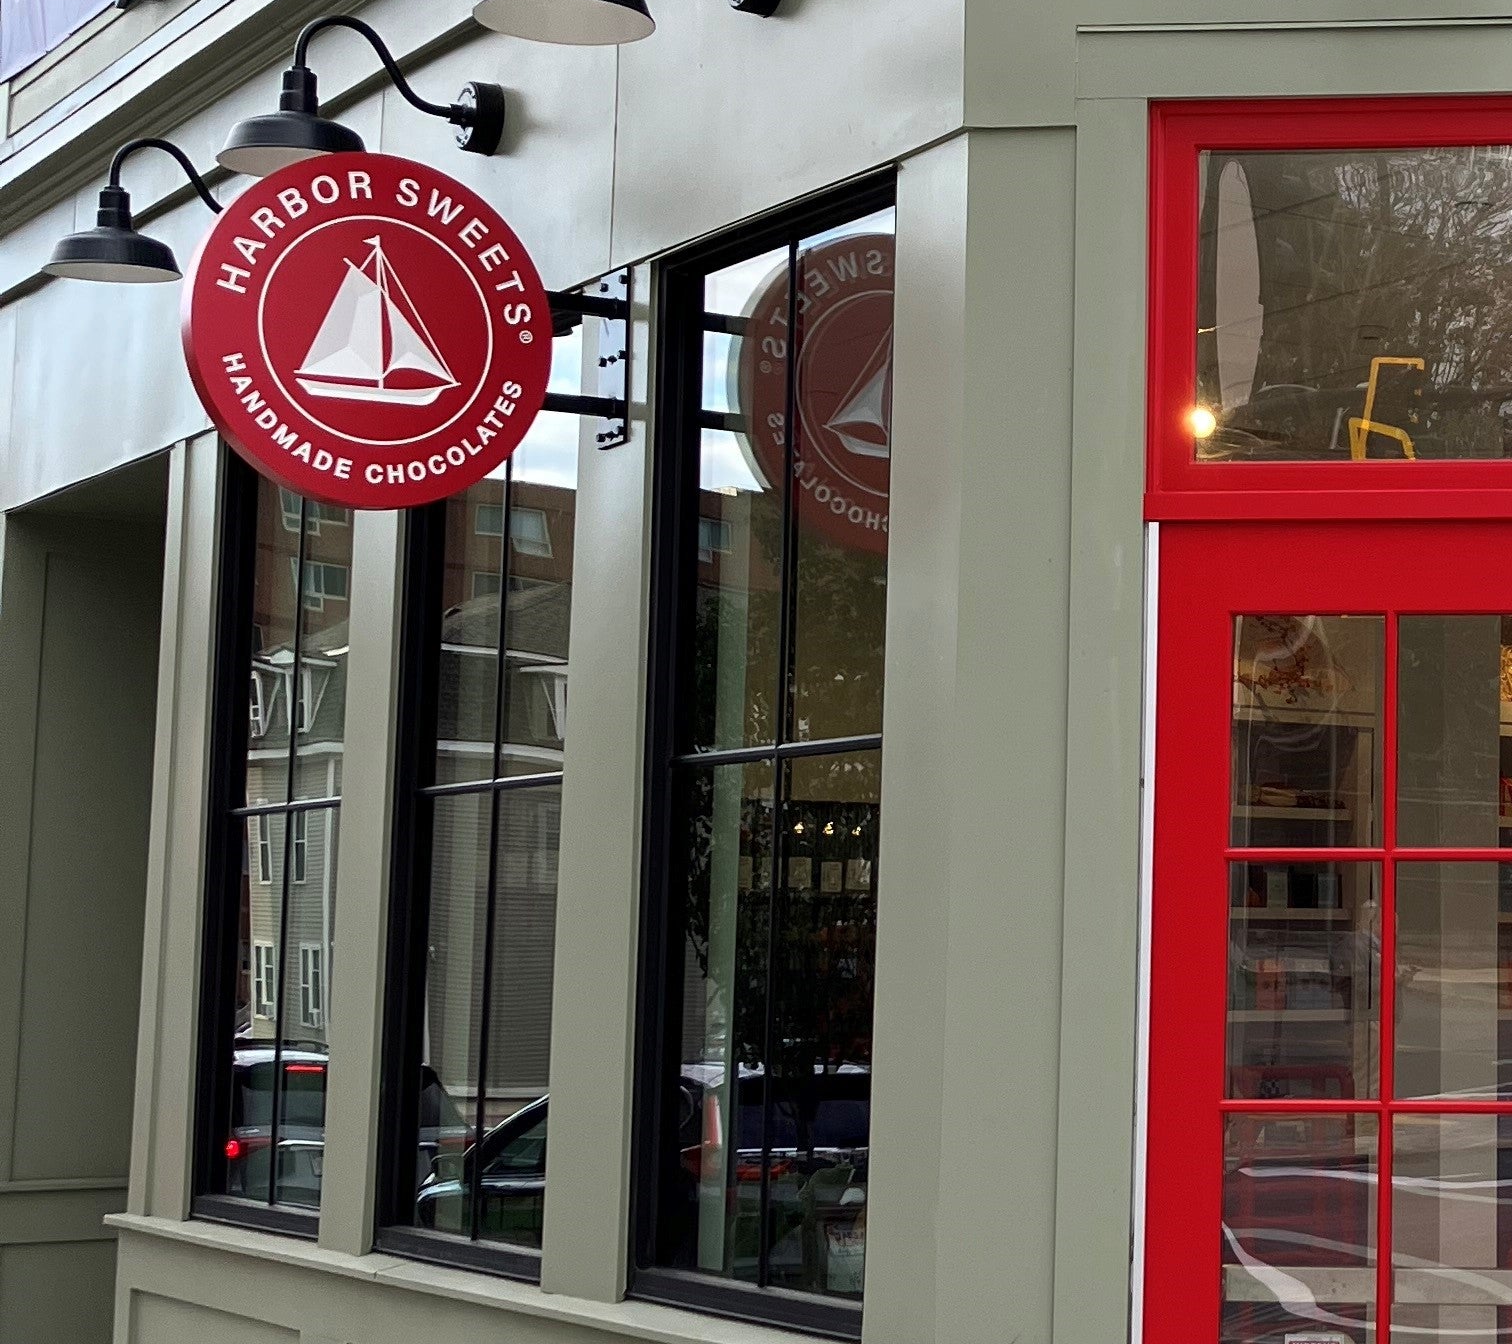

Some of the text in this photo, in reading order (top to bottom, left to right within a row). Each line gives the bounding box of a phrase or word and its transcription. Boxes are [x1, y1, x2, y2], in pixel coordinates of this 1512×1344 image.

[216, 170, 374, 294] HARBOR
[222, 352, 523, 484] HANDMADE CHOCOLATES
